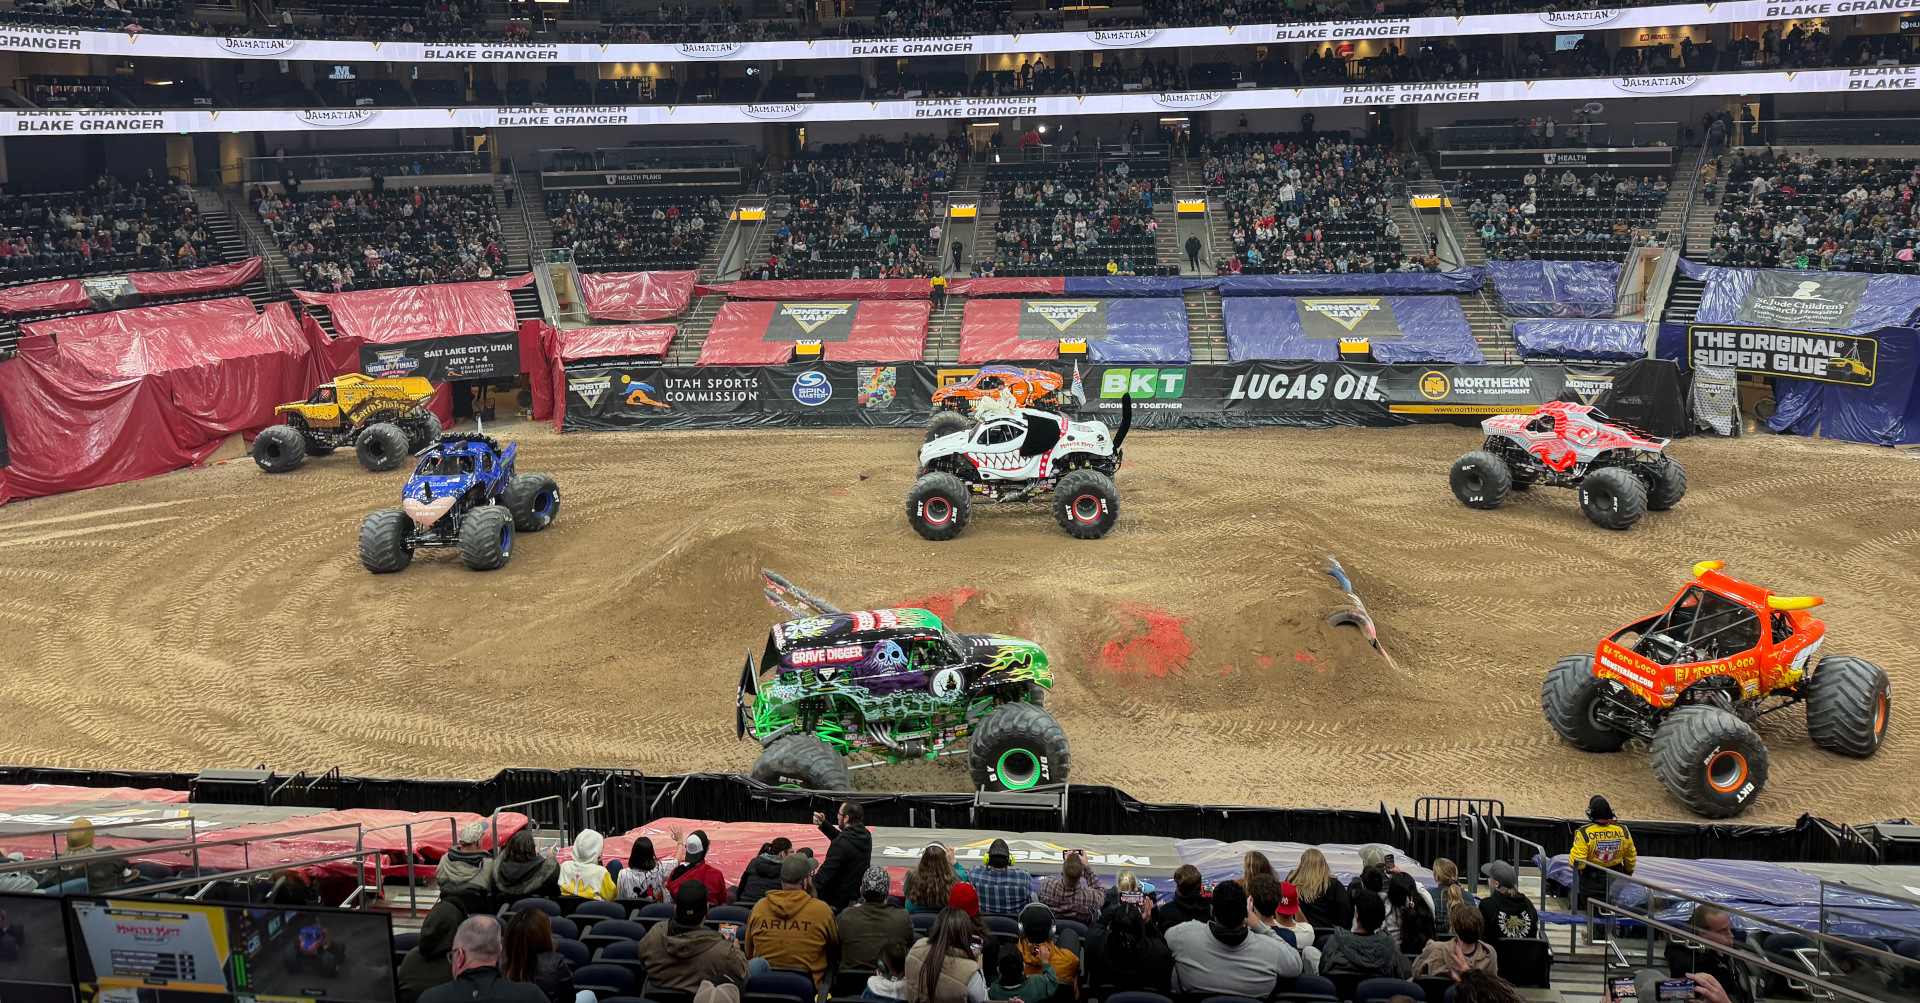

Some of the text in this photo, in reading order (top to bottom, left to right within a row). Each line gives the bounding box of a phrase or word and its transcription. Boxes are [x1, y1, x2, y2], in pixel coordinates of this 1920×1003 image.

[1548, 11, 1609, 22] DALMATIAN
[1766, 4, 1831, 17] BLAKE
[1094, 30, 1147, 41] DALMATIAN
[1276, 25, 1411, 40] BLAKE GRANGER
[225, 38, 285, 50] DALMATIAN
[682, 42, 733, 53] DALMATIAN
[852, 43, 973, 55] BLAKE GRANGER
[424, 50, 559, 60] BLAKE GRANGER
[1622, 76, 1685, 88] DALMATIAN
[1849, 78, 1917, 90] BLAKE
[1160, 92, 1212, 103] DALMATIAN
[1342, 91, 1480, 104] BLAKE GRANGER
[748, 103, 796, 113] DALMATIAN
[915, 106, 1037, 118] BLAKE GRANGER
[304, 109, 362, 120] DALMATIAN
[498, 115, 628, 126] BLAKE GRANGER
[18, 119, 164, 131] BLAKE GRANGER
[1305, 304, 1381, 312] MONSTER
[1753, 302, 1798, 314] Research
[1769, 298, 1793, 308] Jude
[780, 308, 849, 316] MONSTER
[1327, 310, 1361, 318] JAM
[1694, 331, 1737, 349] THE
[424, 344, 513, 358] SALT LAKE CITY, UTAH
[367, 360, 418, 373] WORLD FINALS
[449, 357, 468, 365] JULY
[1694, 350, 1828, 376] SUPER GLUE
[568, 381, 611, 392] MONSTER
[665, 378, 758, 389] UTAH SPORTS
[1103, 374, 1186, 393] BKT
[1230, 374, 1327, 400] LUCAS
[1453, 377, 1530, 388] NORTHERN
[1565, 380, 1613, 390] MONSTER
[1696, 382, 1731, 391] MONSTER
[665, 391, 757, 402] COMMISSION
[1065, 504, 1074, 521] BKT
[1100, 498, 1109, 515] BKT
[792, 646, 863, 665] GRAVE DIGGER
[1703, 746, 1721, 766] BKT
[1039, 756, 1050, 780] BKT
[779, 775, 803, 784] BKT
[1736, 782, 1755, 804] BKT
[1588, 830, 1624, 840] OFFICIAL
[760, 919, 812, 932] ARIAT
